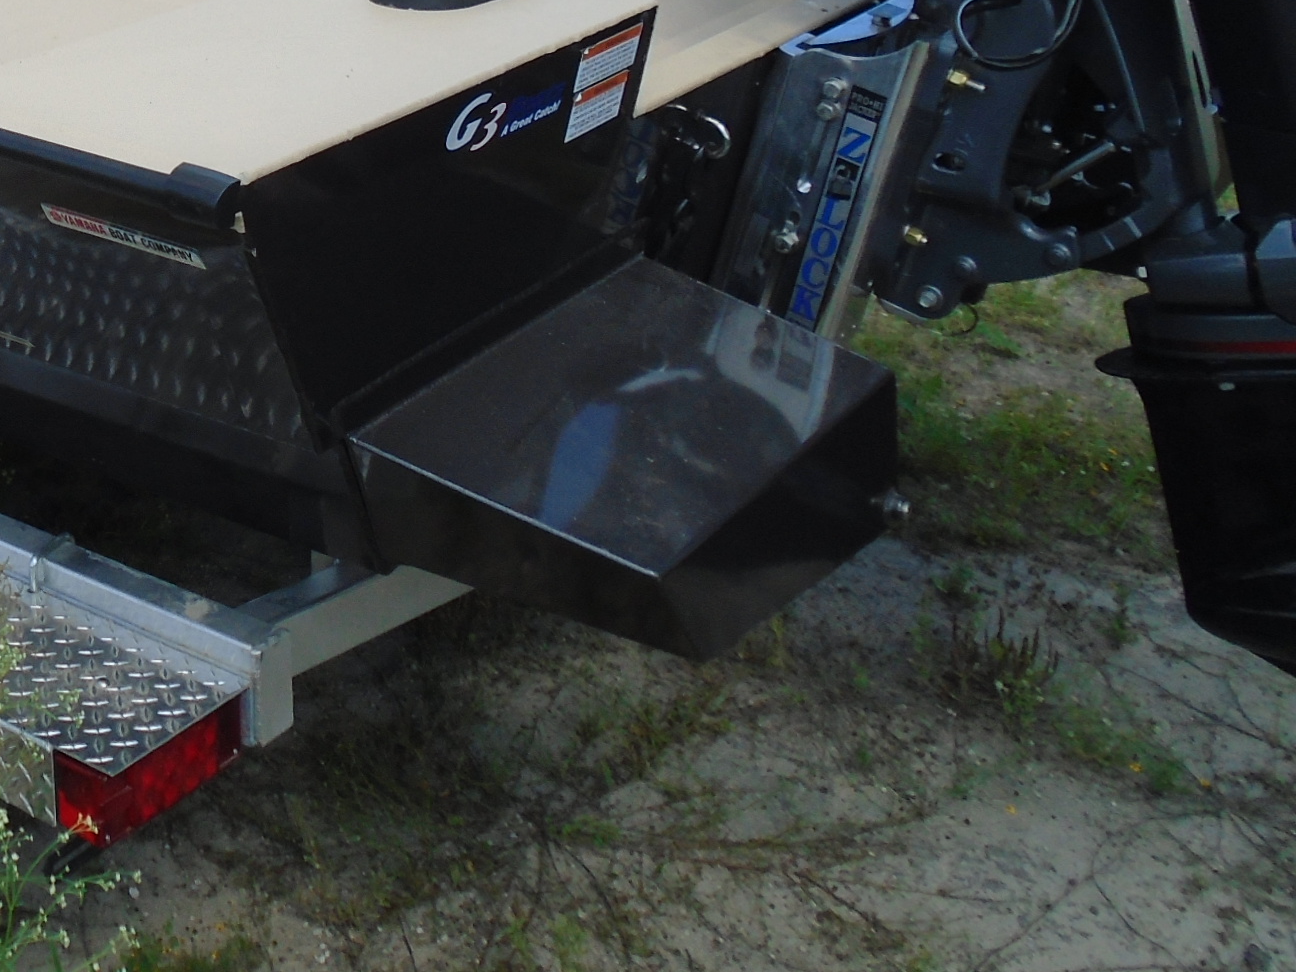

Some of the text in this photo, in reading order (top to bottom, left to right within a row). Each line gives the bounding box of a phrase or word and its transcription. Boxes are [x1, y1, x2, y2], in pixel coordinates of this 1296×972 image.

[445, 92, 507, 152] G3
[509, 113, 534, 133] Great
[60, 212, 195, 263] YAMAHA BOAT COMPANY
[791, 194, 846, 322] LOCK
